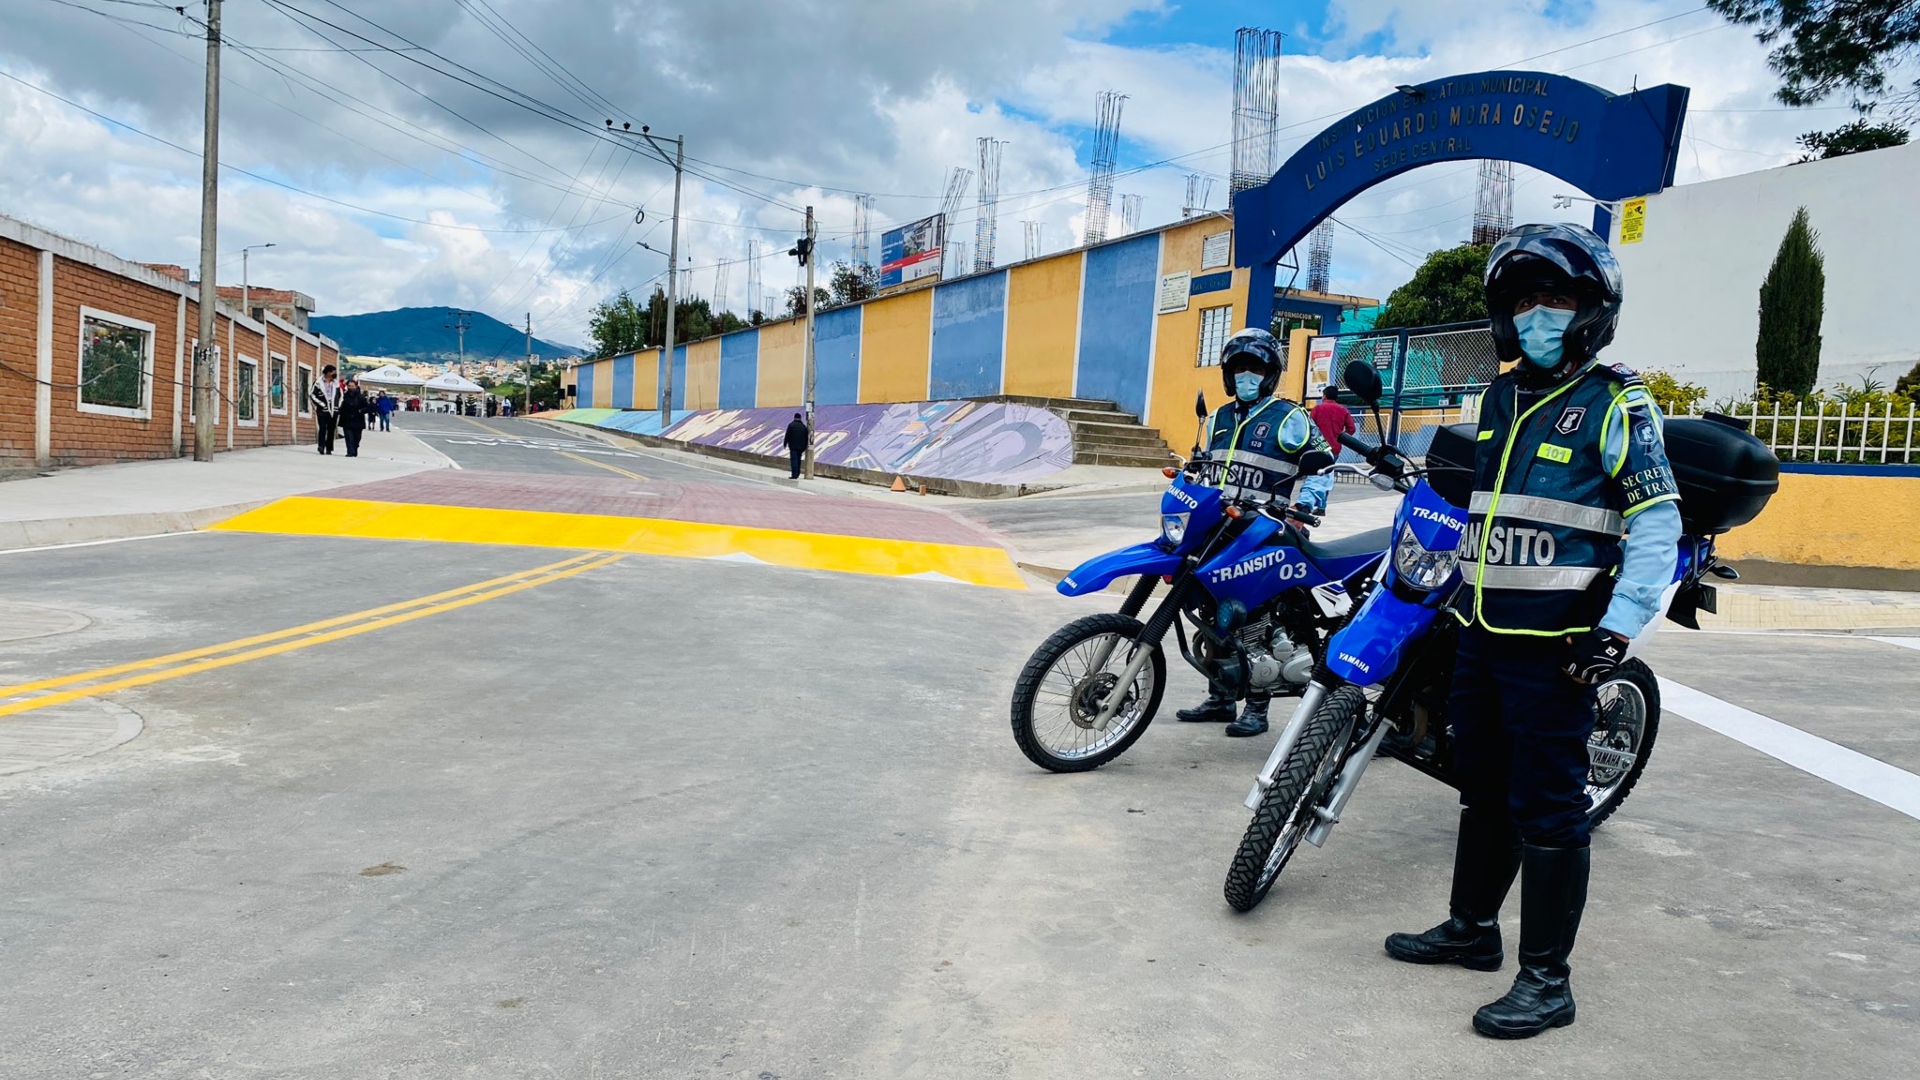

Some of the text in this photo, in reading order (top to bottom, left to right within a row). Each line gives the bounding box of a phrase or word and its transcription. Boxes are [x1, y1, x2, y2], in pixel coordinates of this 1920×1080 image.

[1480, 77, 1549, 97] MUNICIPAL
[1305, 102, 1579, 190] LUIS EDUARDO MORA OSEJO
[1374, 137, 1472, 172] SEDE CENTRAL
[1545, 446, 1567, 461] 101
[1167, 484, 1198, 509] TRANSITO
[1626, 488, 1643, 504] DE
[1412, 506, 1468, 534] TRANSIT
[1459, 522, 1556, 566] ANSITO
[1211, 549, 1307, 584] TRANSITO 03
[1338, 651, 1370, 674] YAMAHA
[1593, 750, 1621, 767] YAMAHA
